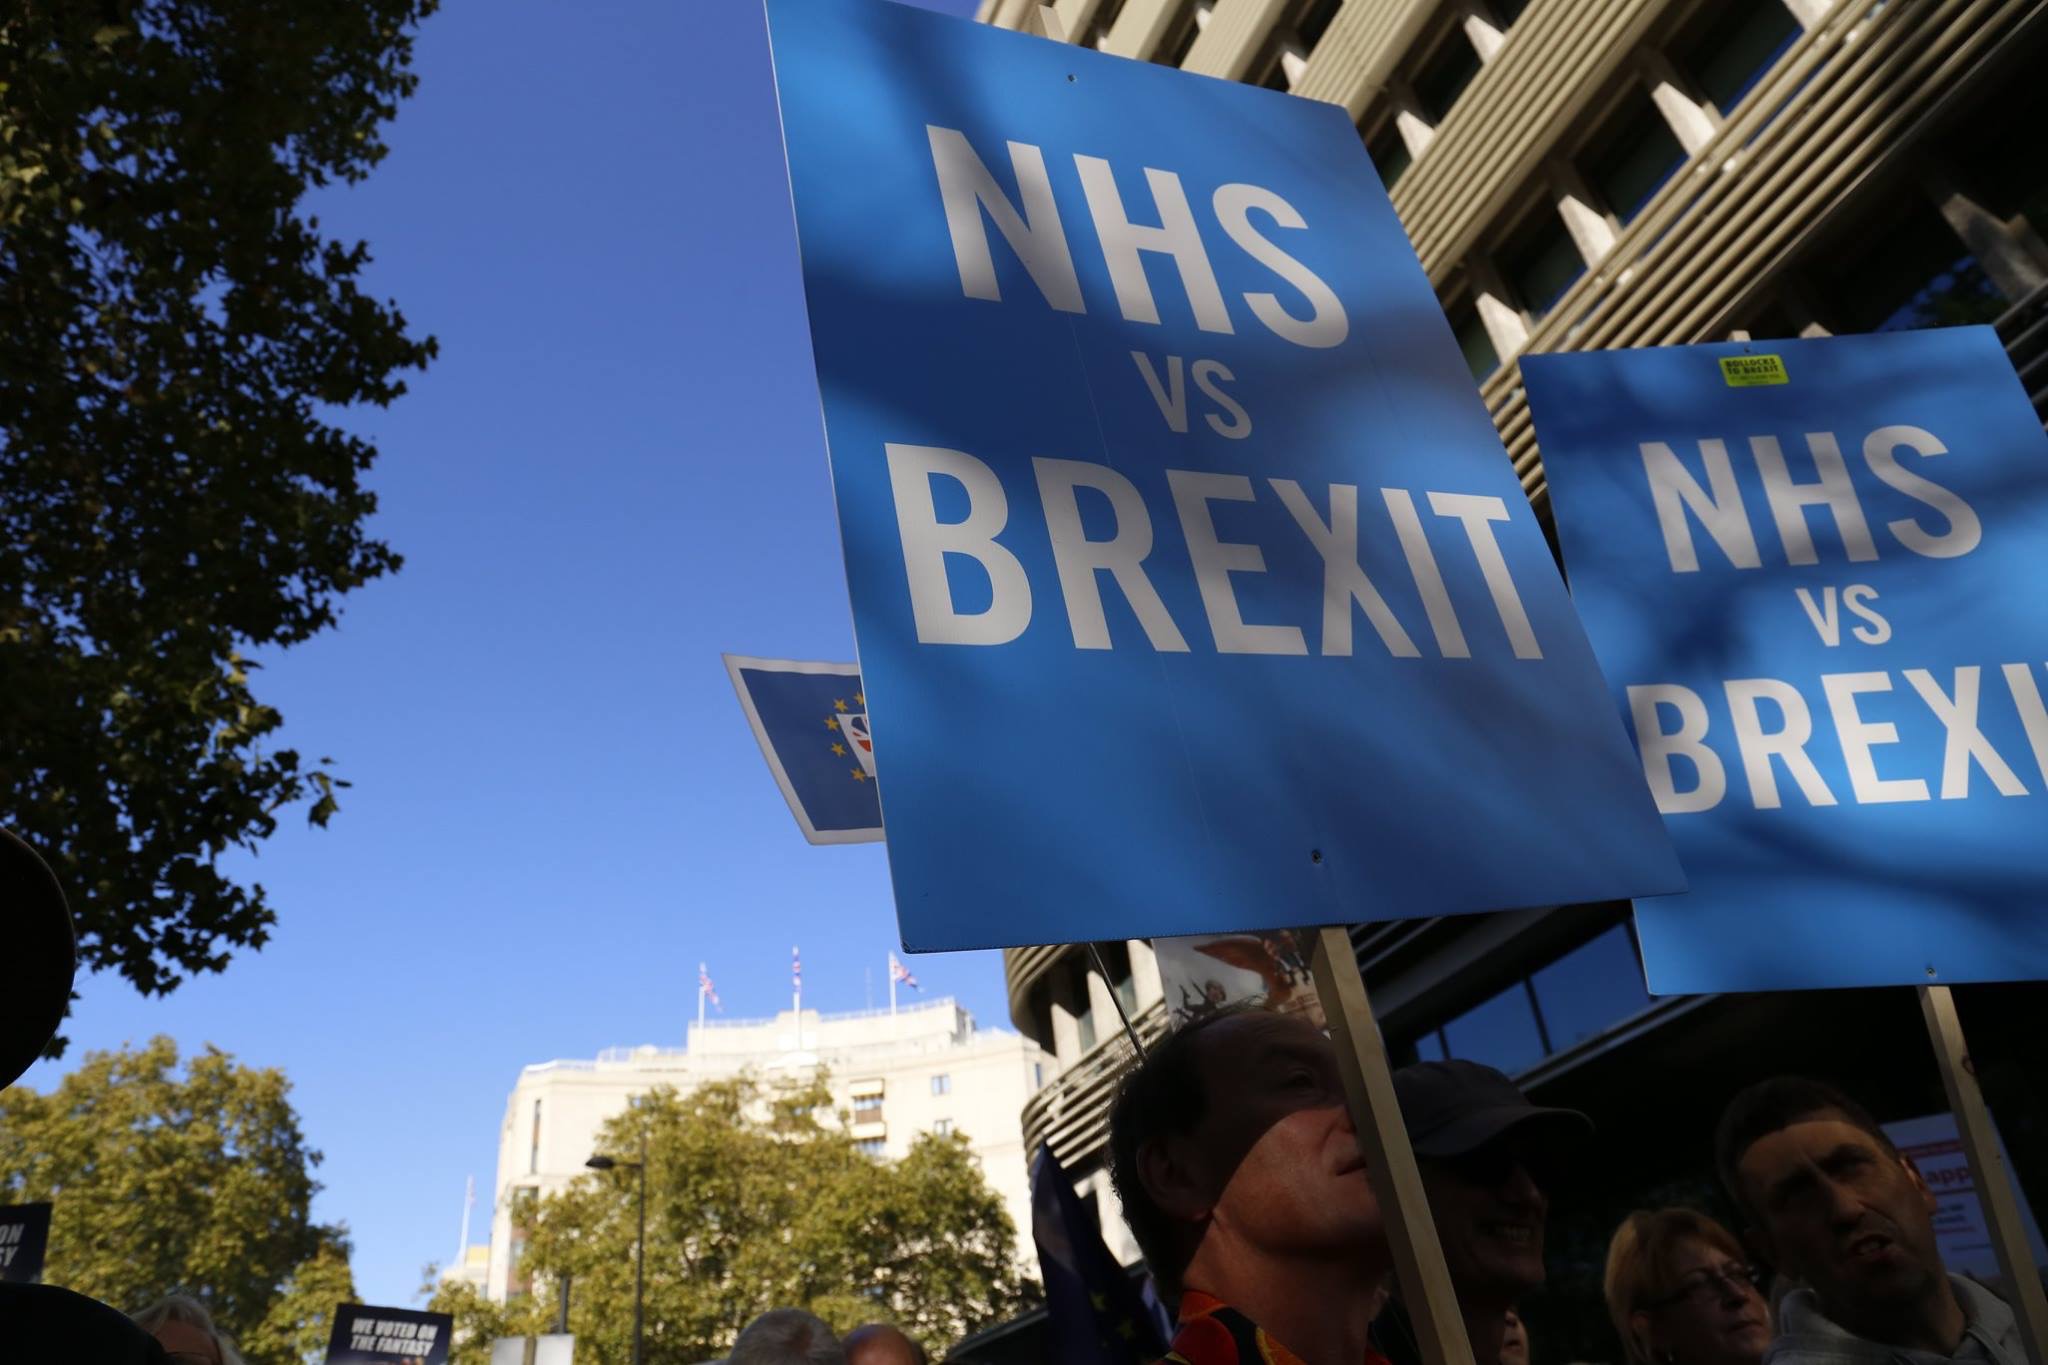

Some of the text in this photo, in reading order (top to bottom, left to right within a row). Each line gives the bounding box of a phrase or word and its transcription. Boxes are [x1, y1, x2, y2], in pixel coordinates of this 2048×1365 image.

[926, 124, 1350, 349] NHS
[1130, 351, 1253, 440] VS
[884, 443, 1544, 660] BREXIT
[1639, 425, 1983, 573] NHS
[1795, 584, 1892, 647] VS
[1626, 662, 2048, 815] BREXI
[350, 1334, 378, 1351] THE
